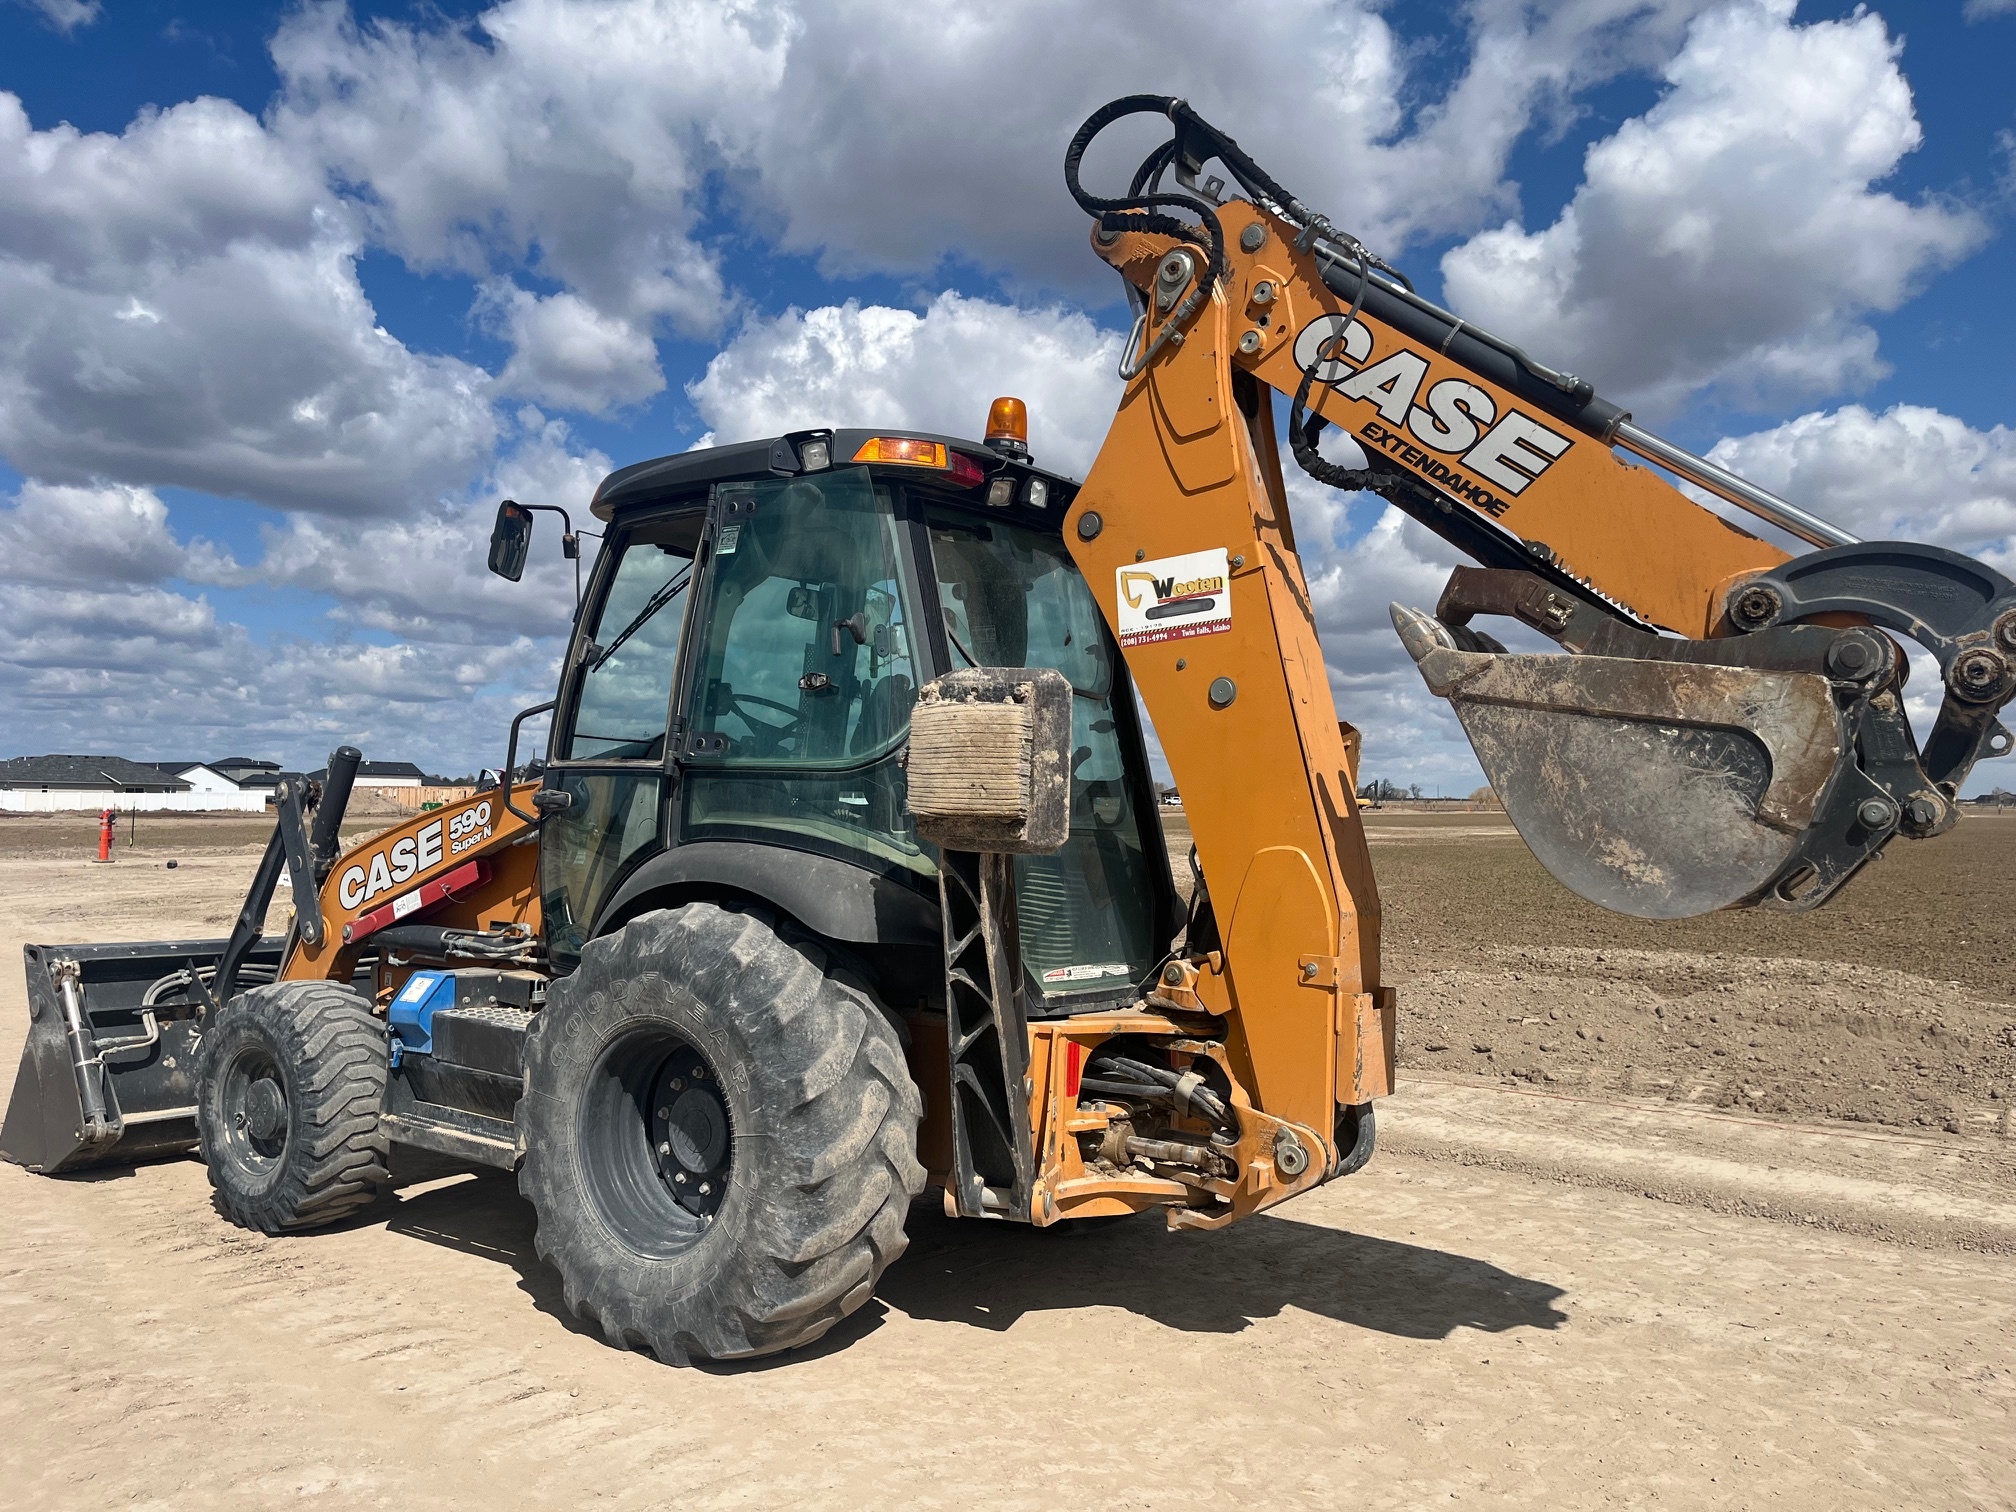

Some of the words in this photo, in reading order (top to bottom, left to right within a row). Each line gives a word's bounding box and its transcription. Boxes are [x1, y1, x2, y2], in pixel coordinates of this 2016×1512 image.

[1293, 312, 1576, 498] CASE
[1359, 421, 1511, 519] EXTENDAHOE
[1152, 576, 1223, 599] Wooten
[1120, 636, 1138, 648] (208)
[1138, 632, 1168, 644] 731-4994
[1181, 628, 1196, 637] Twin
[1196, 626, 1212, 635] Falls,
[1212, 623, 1231, 632] Idaho
[449, 801, 492, 840] 590
[451, 831, 483, 855] Super
[483, 823, 493, 840] N
[339, 818, 443, 911] CASE
